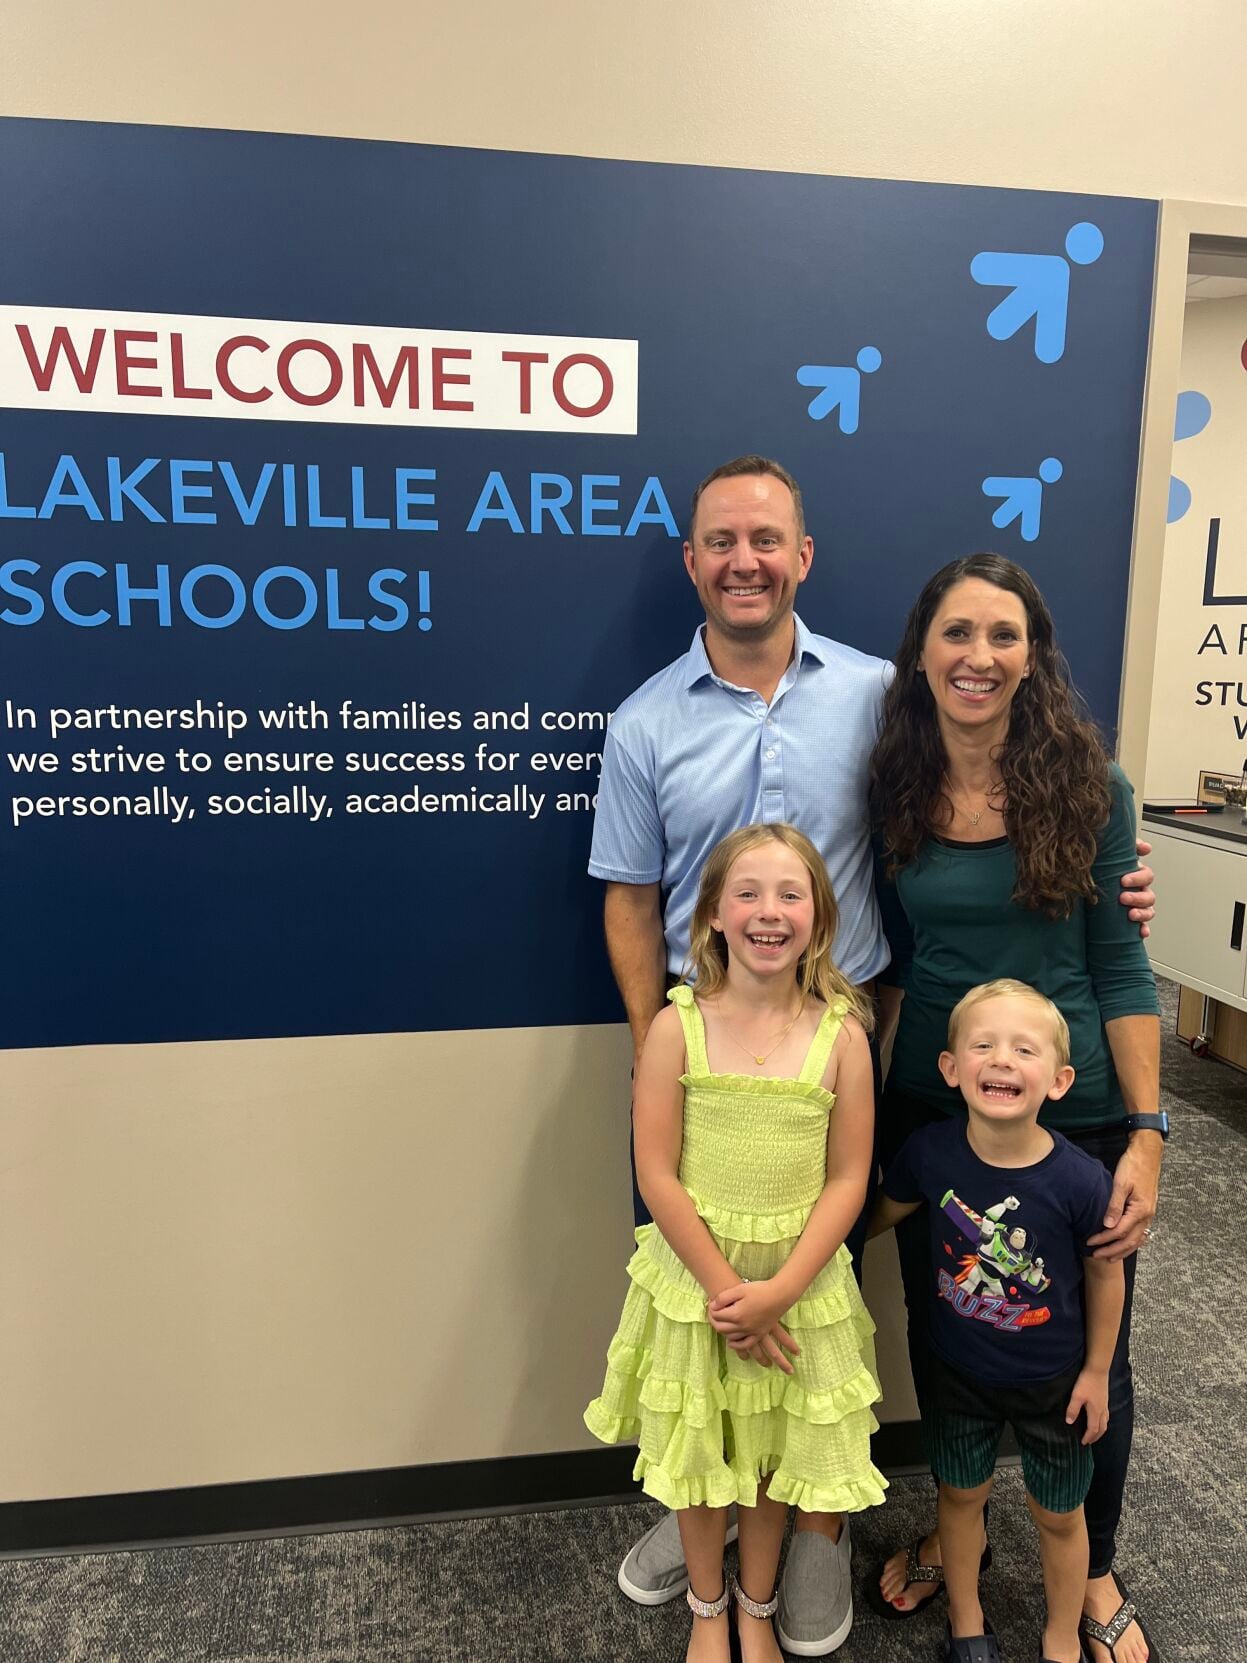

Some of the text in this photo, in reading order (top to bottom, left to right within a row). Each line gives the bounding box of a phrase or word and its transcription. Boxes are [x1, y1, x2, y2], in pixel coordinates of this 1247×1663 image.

[16, 325, 613, 417] WELCOME TO
[0, 452, 681, 537] LAKEVILLE AREA
[0, 559, 433, 632] SCHOOLS!
[6, 700, 37, 729] In
[50, 700, 248, 739] partnership
[258, 701, 329, 730] with
[339, 700, 462, 730] families
[472, 702, 529, 731] and
[7, 753, 59, 773] we
[71, 745, 166, 773] strive
[175, 748, 212, 772] to
[223, 752, 334, 772] ensure
[345, 752, 466, 772] success
[475, 743, 520, 771] for
[12, 786, 195, 827] personally,
[207, 785, 333, 822] socially,
[345, 784, 546, 820] academically
[938, 1268, 1029, 1332] BUZZ
